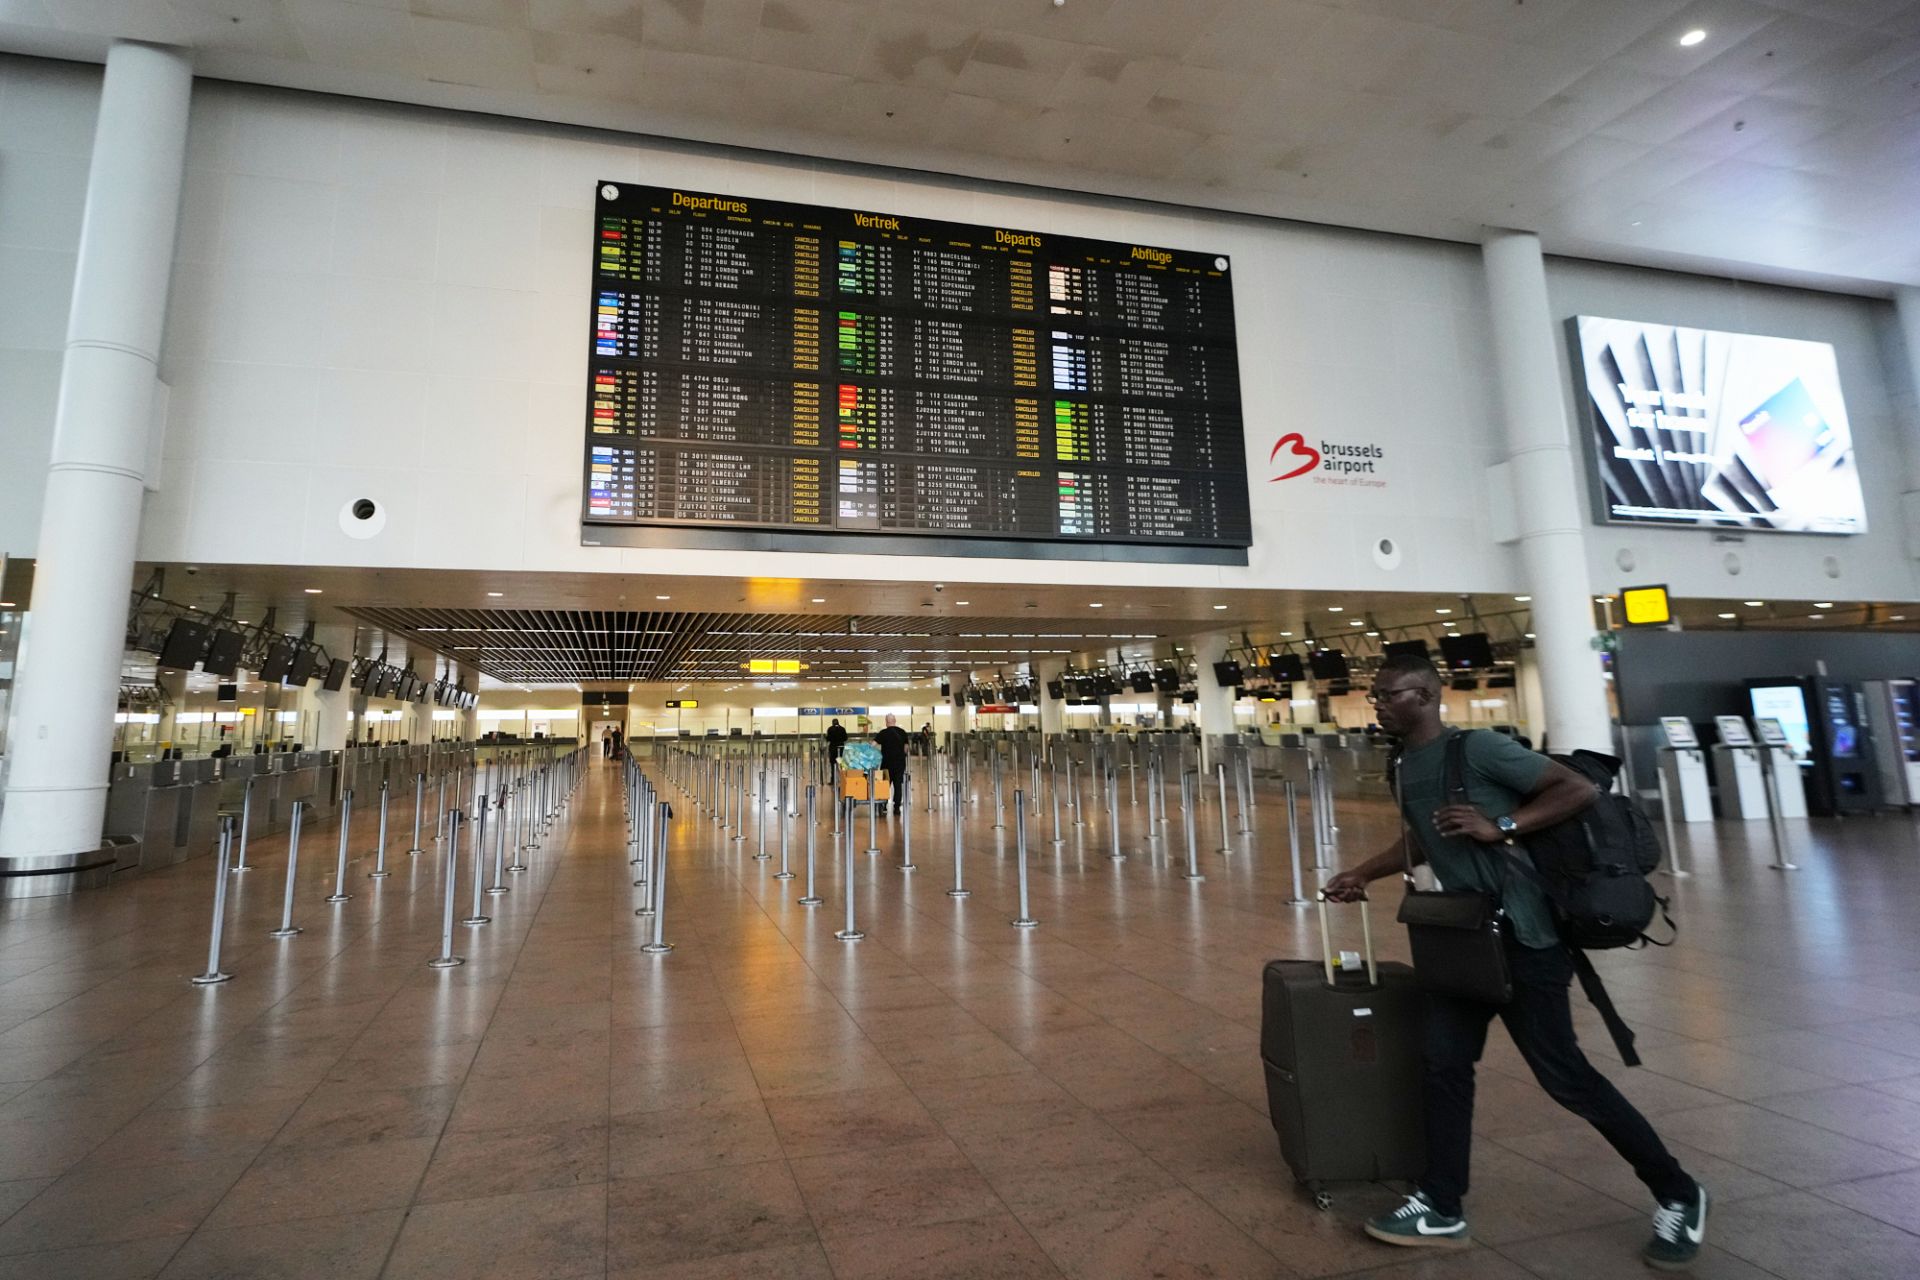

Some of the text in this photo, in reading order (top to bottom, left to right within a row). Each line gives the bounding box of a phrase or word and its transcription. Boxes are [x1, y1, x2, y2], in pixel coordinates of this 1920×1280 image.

[672, 192, 748, 214] Departures
[854, 213, 900, 231] Vertrek
[717, 228, 754, 237] COPENHAGEN
[996, 230, 1041, 247] Départs
[1132, 247, 1172, 264] Abflüge
[716, 302, 760, 310] THESSALONIKI
[1321, 440, 1382, 458] brussels
[1324, 456, 1374, 475] airport
[1360, 478, 1386, 488] Europe
